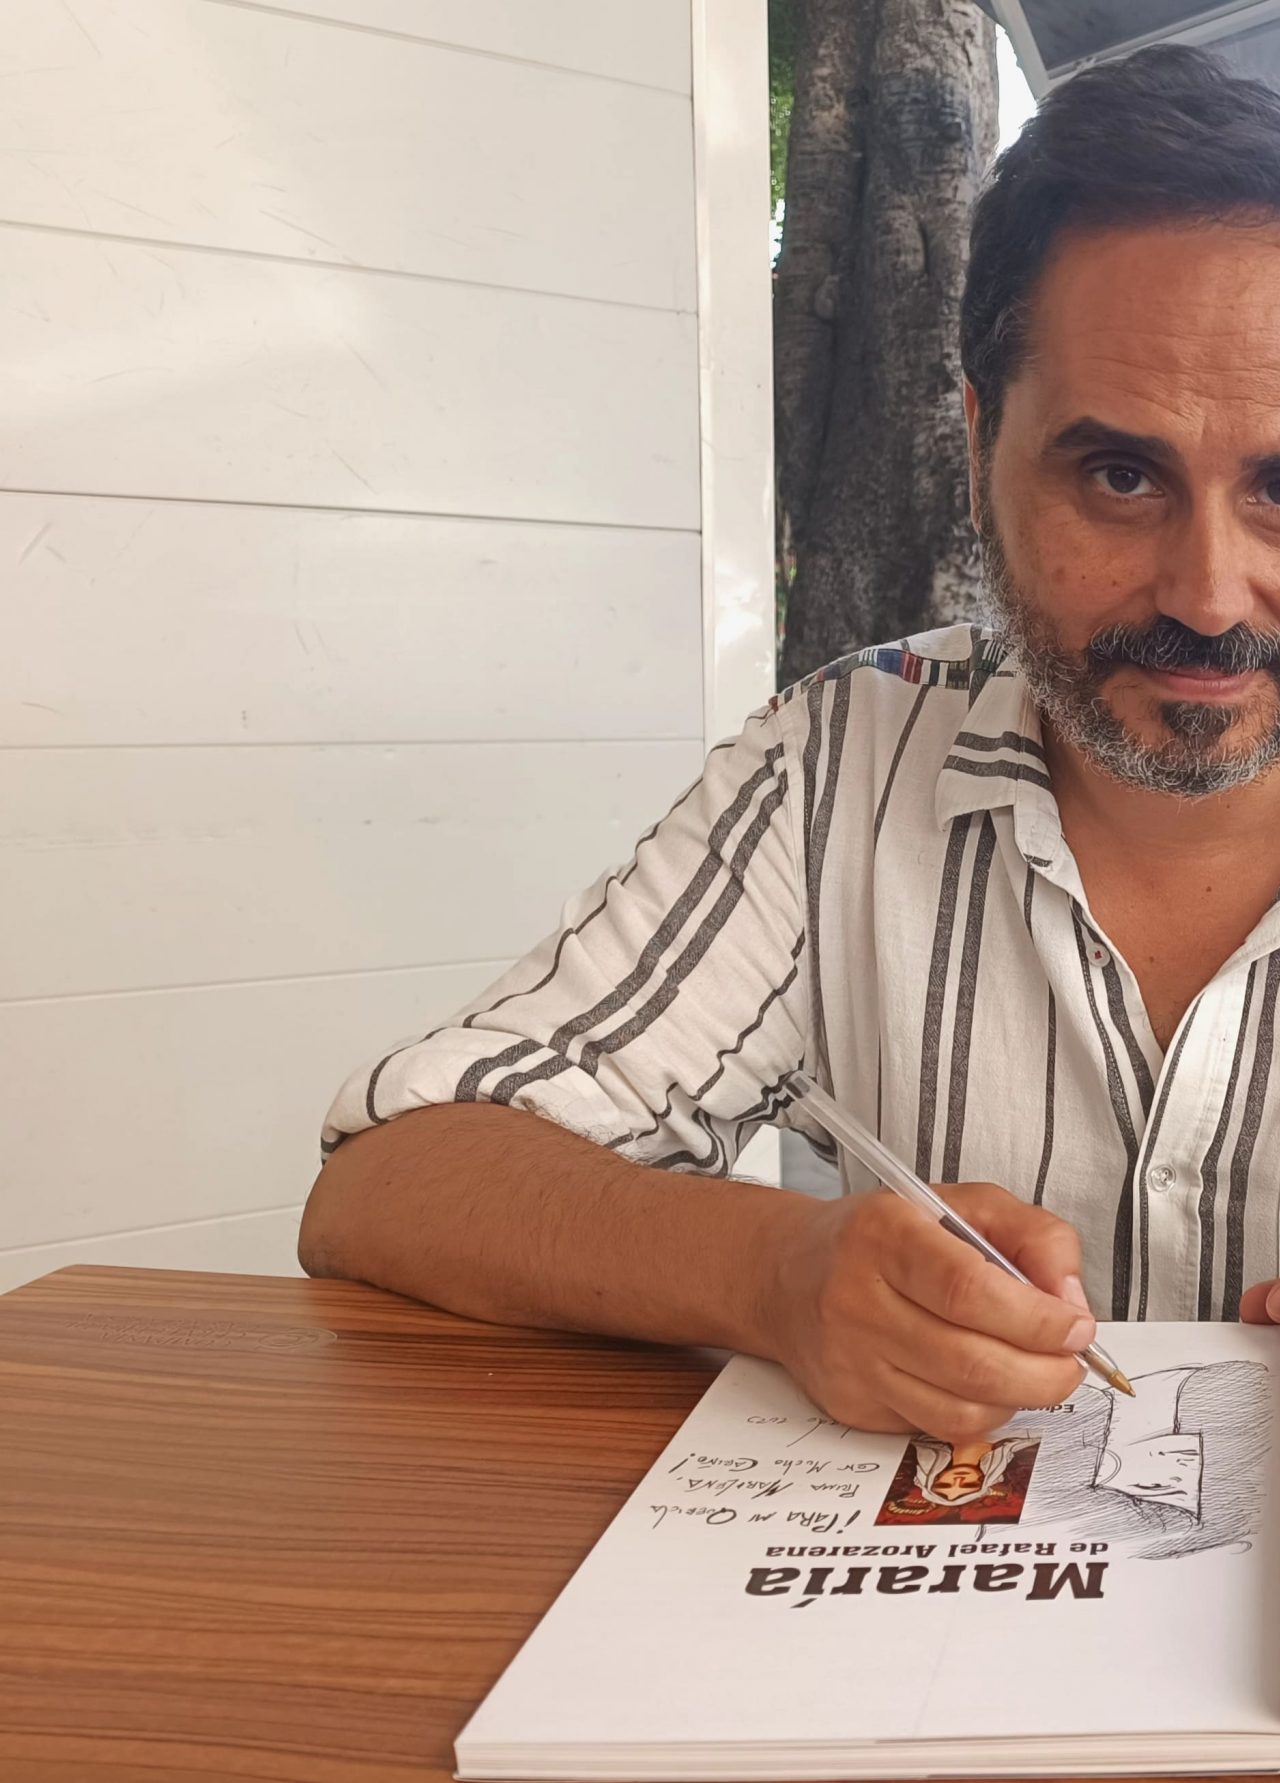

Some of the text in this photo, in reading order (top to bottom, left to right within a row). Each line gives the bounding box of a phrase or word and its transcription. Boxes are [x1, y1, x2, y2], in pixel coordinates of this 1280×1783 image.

[765, 1541, 1110, 1561] de Rafael Arozarena
[744, 1560, 1110, 1609] Mararía
